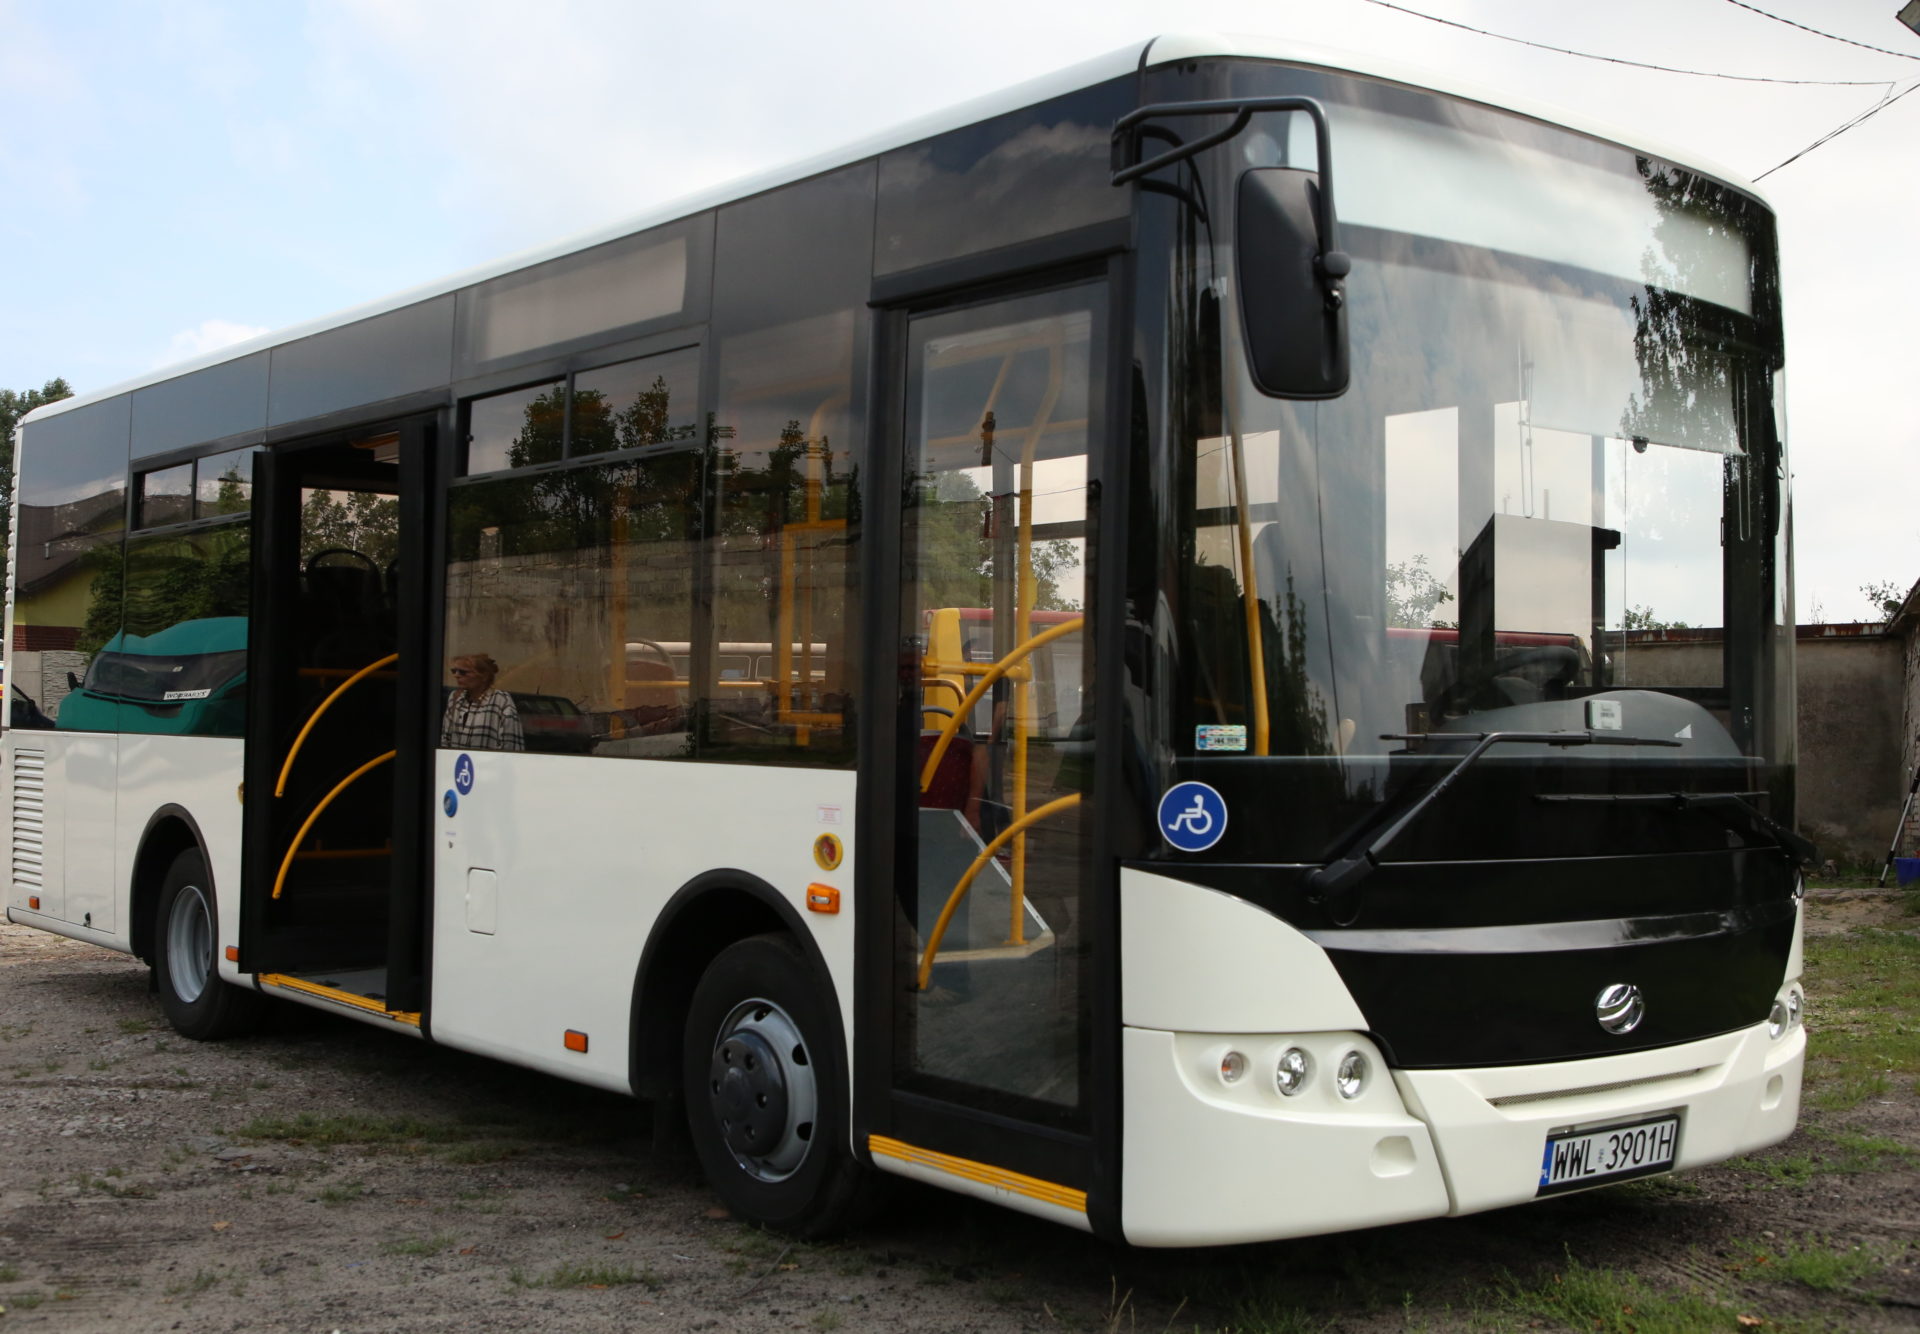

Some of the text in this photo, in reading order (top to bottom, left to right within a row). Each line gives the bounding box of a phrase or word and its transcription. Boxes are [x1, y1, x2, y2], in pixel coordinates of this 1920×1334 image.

[1553, 1123, 1674, 1180] WWL 3901H
[1540, 1168, 1549, 1179] PL
